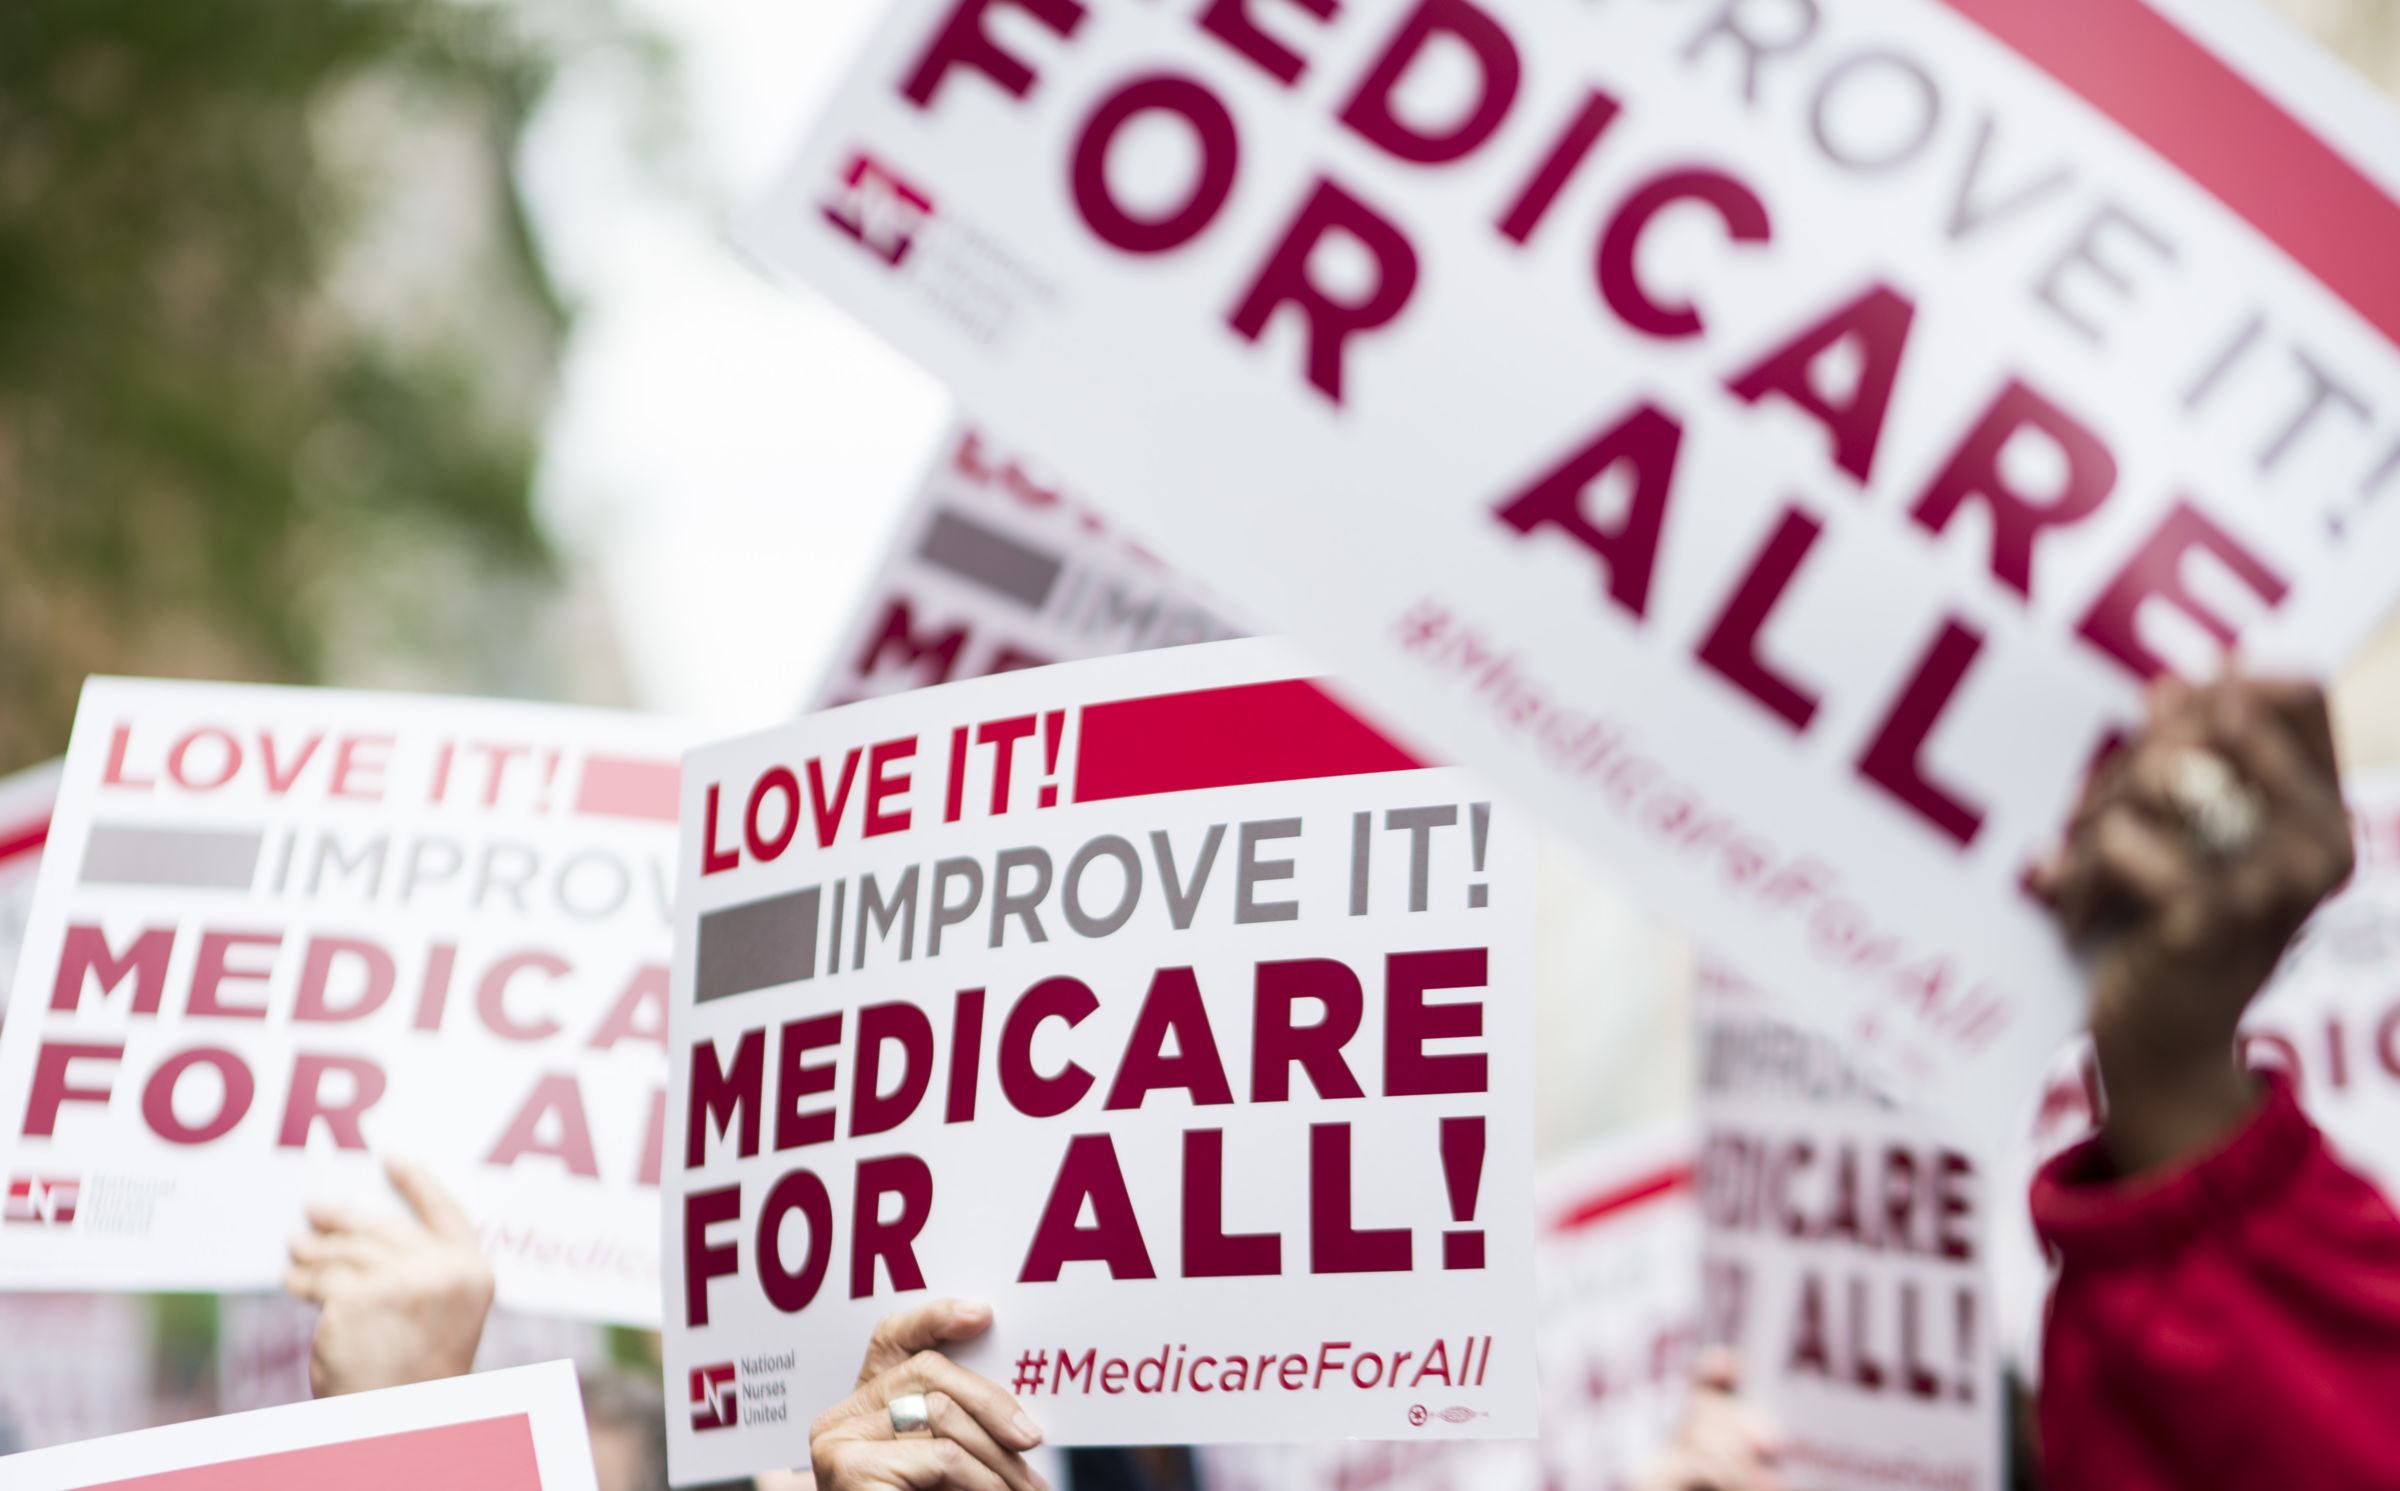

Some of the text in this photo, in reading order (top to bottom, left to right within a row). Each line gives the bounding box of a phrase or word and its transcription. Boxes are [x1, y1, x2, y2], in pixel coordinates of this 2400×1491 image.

[896, 0, 2120, 893] FOR ALL
[101, 722, 568, 816] LOVE IT!
[699, 708, 1067, 877] LOVE IT!
[826, 800, 1492, 977] IMPROVE IT!
[20, 1039, 388, 1153] FOR
[684, 946, 1490, 1171] MEDICARE
[683, 1114, 1487, 1330] FOR ALL!
[740, 1348, 797, 1377] National
[742, 1379, 788, 1401] Nurses
[1010, 1334, 1493, 1397] #MedicareForAll
[1788, 1268, 1977, 1404] ALL!
[743, 1403, 788, 1427] United
